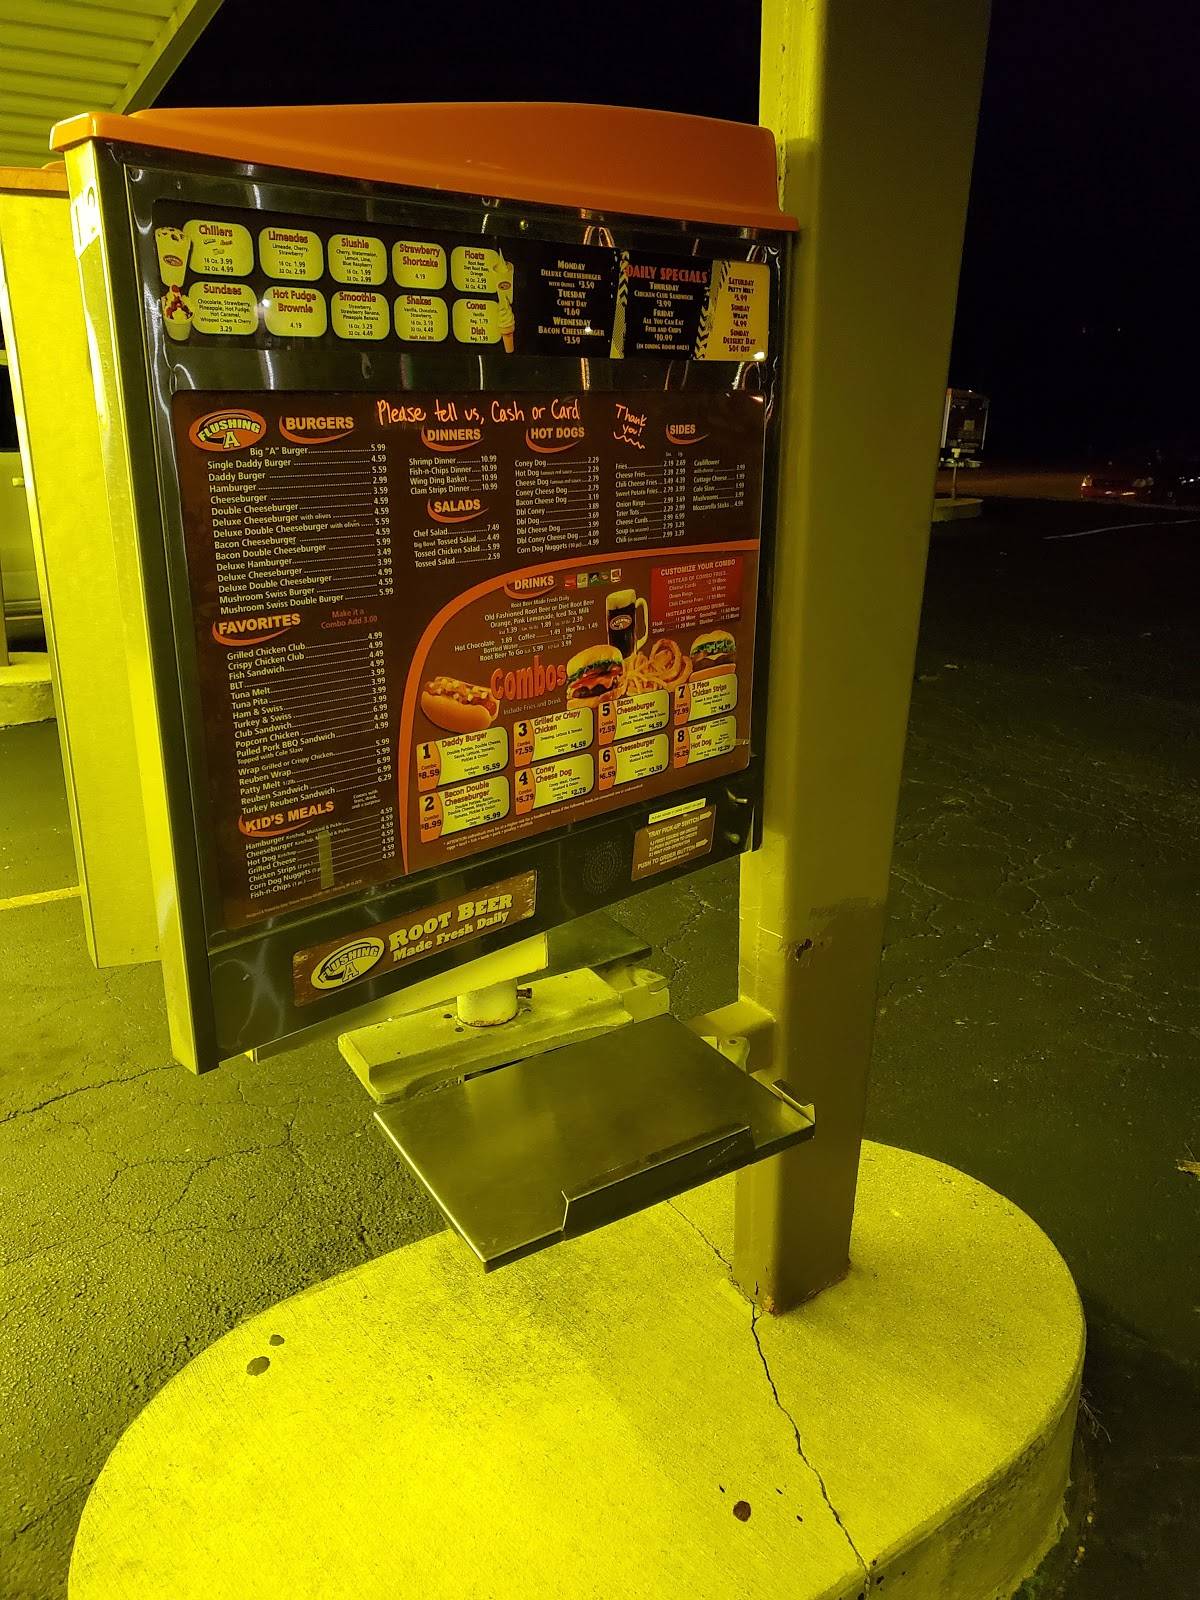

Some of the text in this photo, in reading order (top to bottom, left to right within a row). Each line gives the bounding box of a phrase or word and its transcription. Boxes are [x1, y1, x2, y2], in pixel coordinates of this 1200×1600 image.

[200, 224, 233, 238] Chillers
[268, 231, 309, 244] Limeades
[341, 238, 369, 249] Slushie
[400, 244, 440, 258] Strawberry
[464, 250, 485, 260] Floats
[402, 256, 438, 268] Shortcake
[204, 284, 242, 296] Sundaes
[272, 290, 317, 302] Hot Fudge
[339, 292, 377, 303] Smoothie
[406, 296, 432, 306] Shakes
[278, 303, 313, 314] Brownie
[466, 302, 487, 311] Cones
[472, 327, 486, 335] Dish
[376, 399, 581, 425] Please tell us, Cash or Card
[616, 404, 647, 427] Thank
[198, 418, 261, 442] FLUSHING
[286, 417, 355, 431] BURGERS
[670, 424, 696, 435] SIDES
[427, 429, 481, 441] DINNERS
[531, 427, 585, 439] HOT DOGS
[223, 432, 240, 449] A
[281, 446, 308, 457] Burger
[208, 458, 291, 471] Single Daddy Burger
[409, 456, 456, 467] Shrimp Dinner
[515, 460, 547, 469] Coney Dog
[450, 466, 472, 474] Dinner
[527, 469, 539, 478] Dog
[616, 472, 633, 480] Cheese
[208, 472, 266, 484] Daddy Burger
[516, 478, 549, 488] Cheese Dog
[210, 484, 257, 494] Hamburger
[448, 484, 470, 493] Dinner
[516, 486, 568, 498] Coney Cheese Dog
[210, 494, 268, 505] Cheeseburger
[434, 499, 481, 513] SALADS
[212, 503, 299, 516] Double Cheeseburger
[212, 514, 299, 527] Deluxe Cheeseburger
[616, 518, 633, 526] Cheese
[214, 522, 329, 539] Deluxe Double Cheeseburger
[414, 528, 448, 538] Chef Salad
[214, 536, 297, 550] Bacon Cheeseburger
[460, 536, 477, 544] Salad
[215, 544, 327, 561] Bacon Double Cheeseburger
[414, 545, 480, 559] Tossed Chicken Salad
[216, 558, 292, 572] Deluxe Hamburger
[414, 560, 436, 569] Tossed
[661, 565, 696, 577] CUSTOMIZE
[218, 568, 303, 583] Deluxe Cheeseburger
[218, 575, 332, 594] Deluxe Double Cheeseburger
[514, 575, 554, 591] DRINKS
[220, 588, 315, 605] Mushroom Burger
[220, 594, 344, 616] Mushroom Double Burger
[525, 608, 538, 616] Root
[218, 613, 301, 635] FAVORITES
[466, 633, 536, 651] Chocolate Coffee
[227, 646, 286, 661] Grilled Chicken
[228, 656, 285, 672] Crispy Chicken
[247, 666, 285, 678] Sandwich
[490, 655, 567, 700] Combos
[230, 682, 244, 691] BLT
[230, 688, 271, 701] Tuna Melt
[602, 704, 611, 717] 5
[617, 701, 656, 716] Cheeseburger
[234, 720, 261, 730] Turkey
[254, 722, 292, 734] Sandwich
[534, 716, 553, 727] Grilled
[518, 723, 528, 737] 3
[534, 724, 557, 735] Chicken
[236, 731, 299, 749] Popcorn Chicken
[237, 732, 336, 758] Pulled BBQ Sandwich
[442, 732, 488, 748] Daddy Burger
[617, 738, 655, 754] Cheeseburger
[423, 746, 431, 760] 1
[603, 750, 611, 763] 6
[239, 774, 269, 786] Reuben
[518, 772, 528, 786] 4
[536, 774, 558, 784] Cheese
[240, 786, 261, 797] Patty
[241, 784, 309, 805] Reuben Sandwich
[445, 782, 490, 798] Bacon Double
[242, 787, 335, 816] Turkey Reuben Sandwich
[424, 797, 435, 812] 2
[445, 790, 489, 807] Cheeseburger
[246, 813, 284, 833] KID'S
[288, 801, 335, 822] MEALS
[246, 836, 285, 851] Hamburger
[246, 842, 294, 859] Cheeseburger
[248, 858, 297, 875] Grilled Cheese
[248, 864, 297, 883] Chicken Strips
[250, 870, 311, 892] Corn Nuggets
[390, 894, 514, 951] ROOT BEER
[393, 911, 509, 962] Made Fresh Daily
[320, 946, 378, 983] FLUSHING
[342, 961, 359, 983] A
